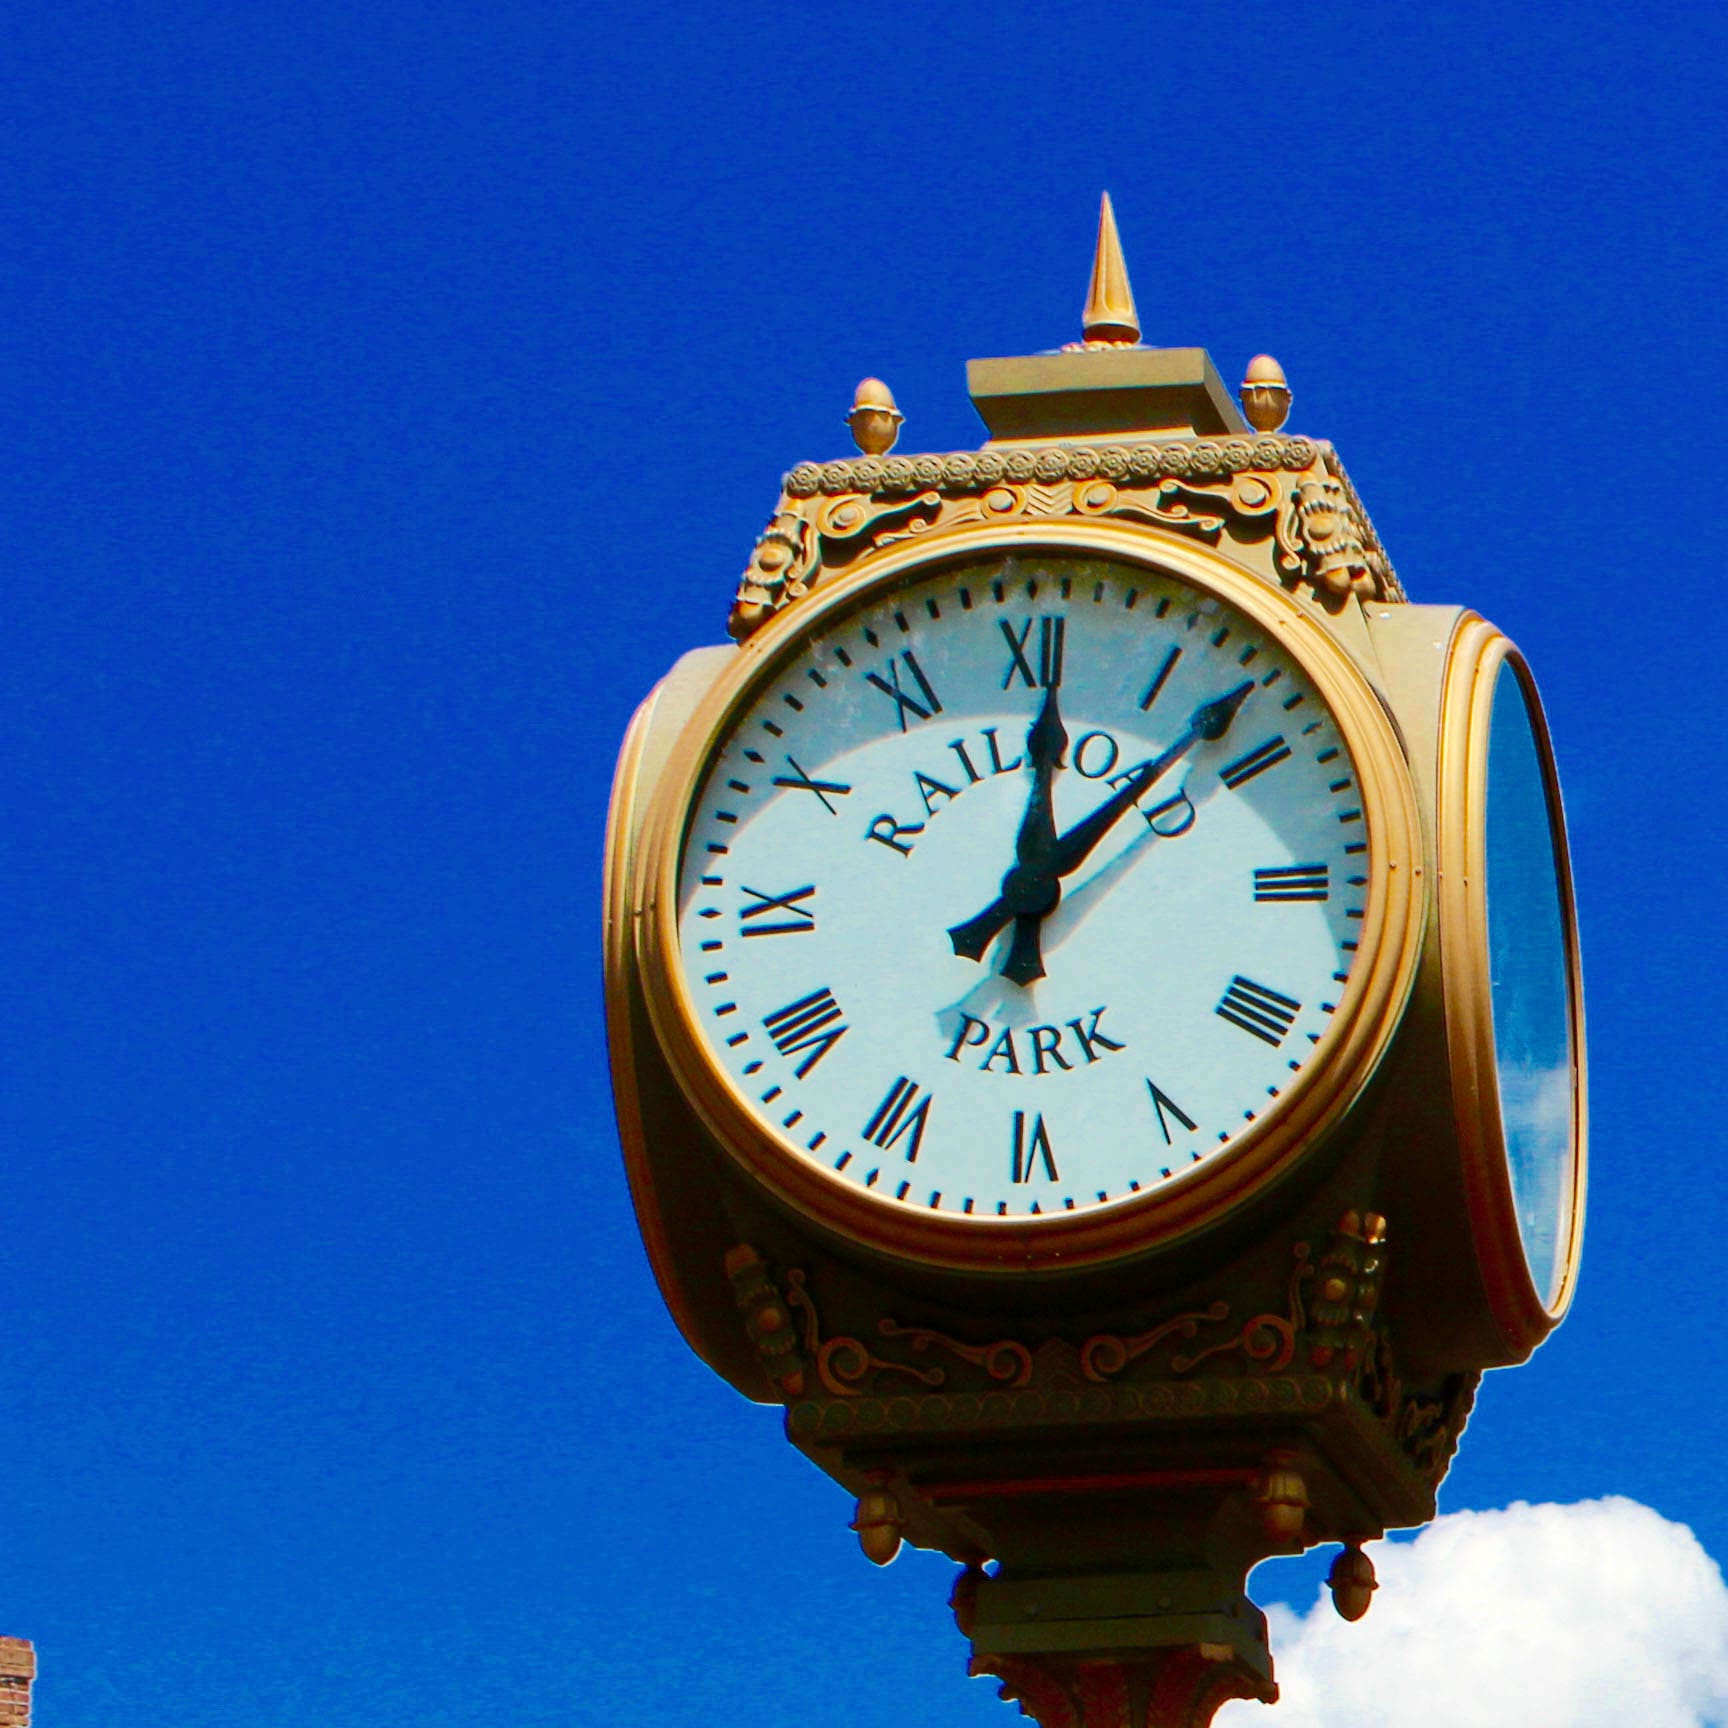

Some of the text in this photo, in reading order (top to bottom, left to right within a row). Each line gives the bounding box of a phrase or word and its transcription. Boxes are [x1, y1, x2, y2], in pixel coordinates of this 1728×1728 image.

[1000, 616, 1064, 690] XII
[1142, 645, 1184, 711] I
[864, 649, 942, 733] XI
[772, 755, 851, 815] X
[865, 725, 1196, 857] RAILOAD
[1219, 735, 1292, 790] II
[739, 885, 815, 937] IX
[1253, 863, 1329, 902] III
[761, 987, 849, 1081] VIII
[944, 1005, 1126, 1076] PARK
[1215, 975, 1302, 1048] IIII
